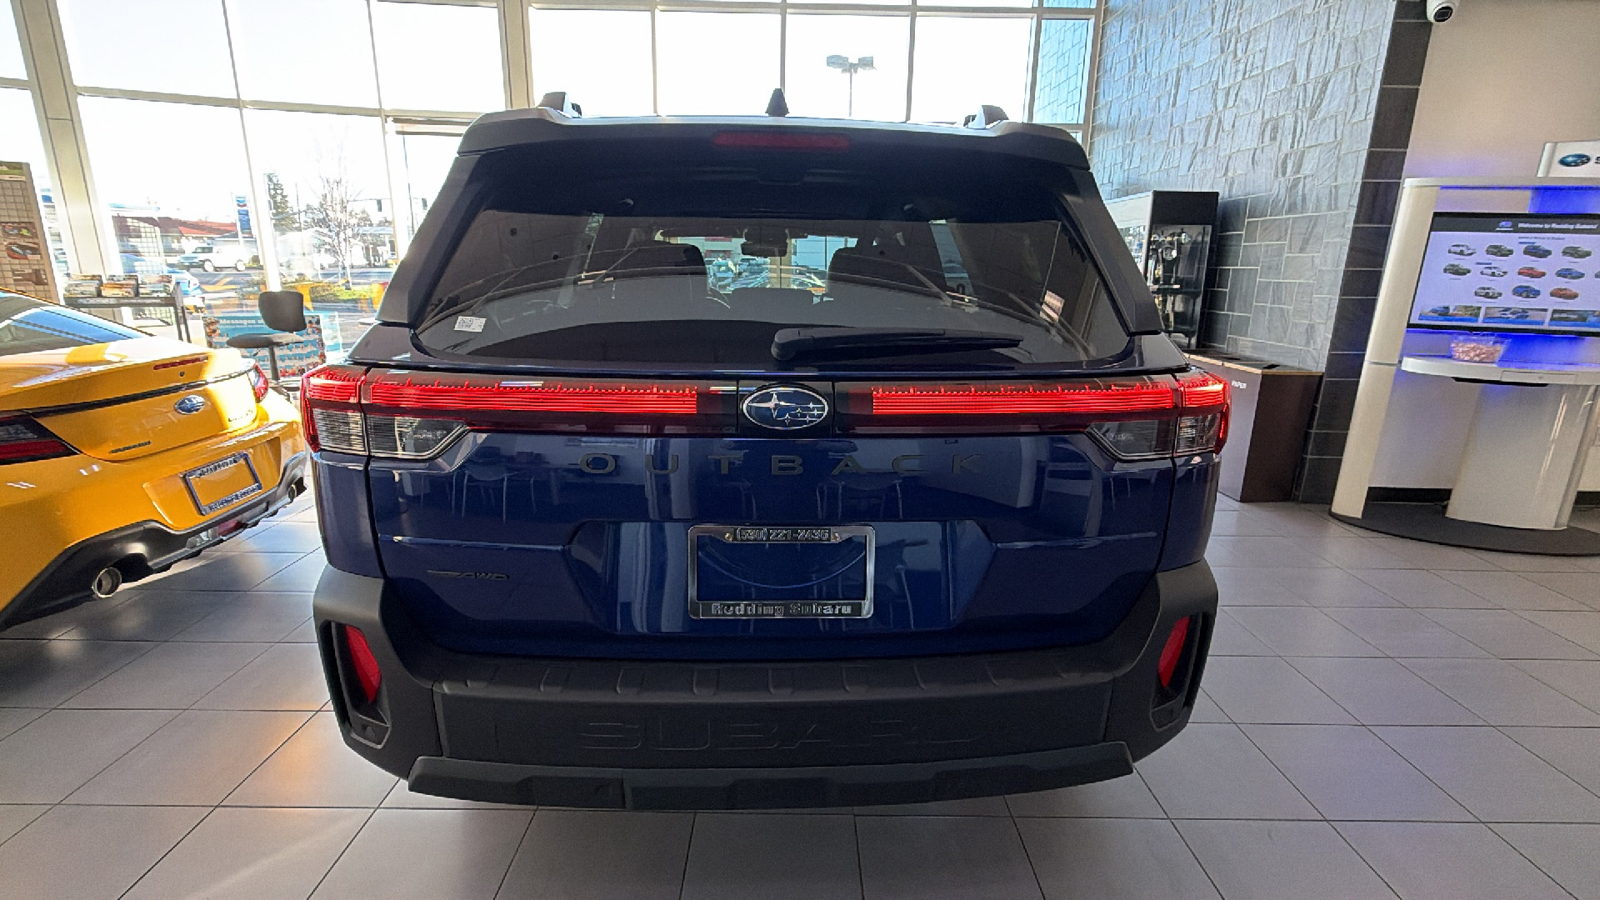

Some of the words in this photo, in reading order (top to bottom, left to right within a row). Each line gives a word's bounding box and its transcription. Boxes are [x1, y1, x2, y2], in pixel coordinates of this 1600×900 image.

[1231, 380, 1247, 389] PAPER
[578, 452, 982, 476] OUTBACK
[736, 527, 768, 541] (530)
[769, 529, 829, 541] 221-2436
[711, 603, 784, 617] Redding
[789, 603, 852, 615] Subaru
